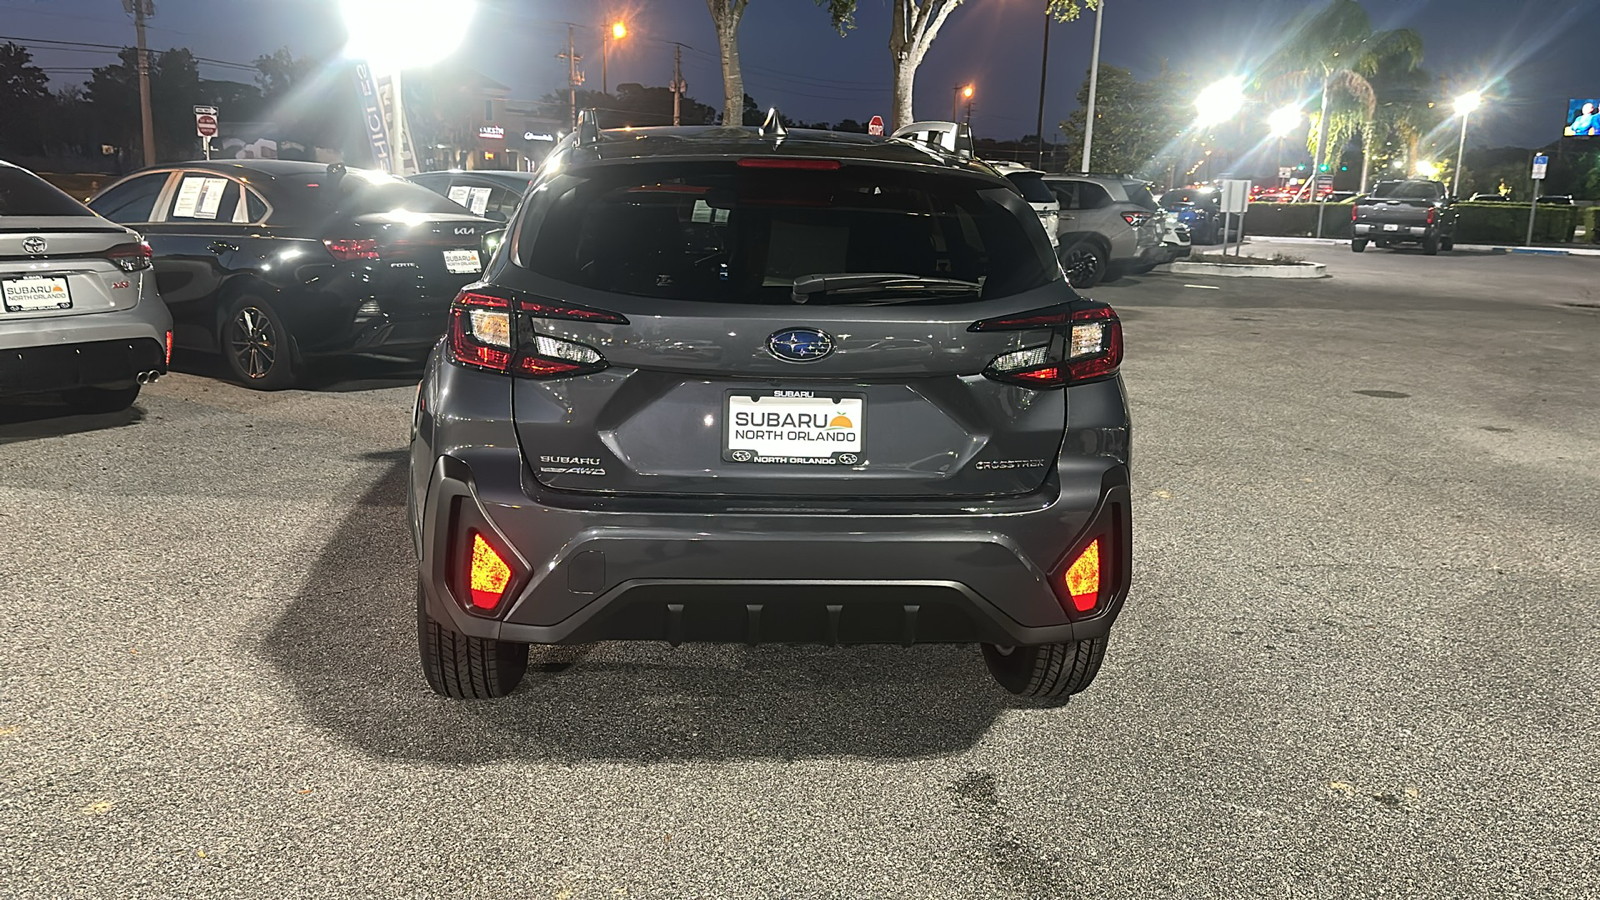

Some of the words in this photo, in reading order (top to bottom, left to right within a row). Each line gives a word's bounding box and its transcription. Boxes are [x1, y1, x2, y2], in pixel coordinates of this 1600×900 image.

[869, 125, 884, 136] STOP
[6, 285, 52, 295] SUBARU
[33, 292, 67, 300] ORLANDO
[773, 390, 815, 398] SUBARU
[735, 412, 828, 428] SUBARU
[735, 429, 783, 440] NORTH
[787, 431, 856, 442] ORLANDO
[540, 455, 601, 465] SUBARU
[753, 456, 788, 464] NORTH
[789, 457, 837, 465] ORLANDO
[975, 459, 1044, 470] CROSSTREK
[565, 467, 606, 476] AWD
